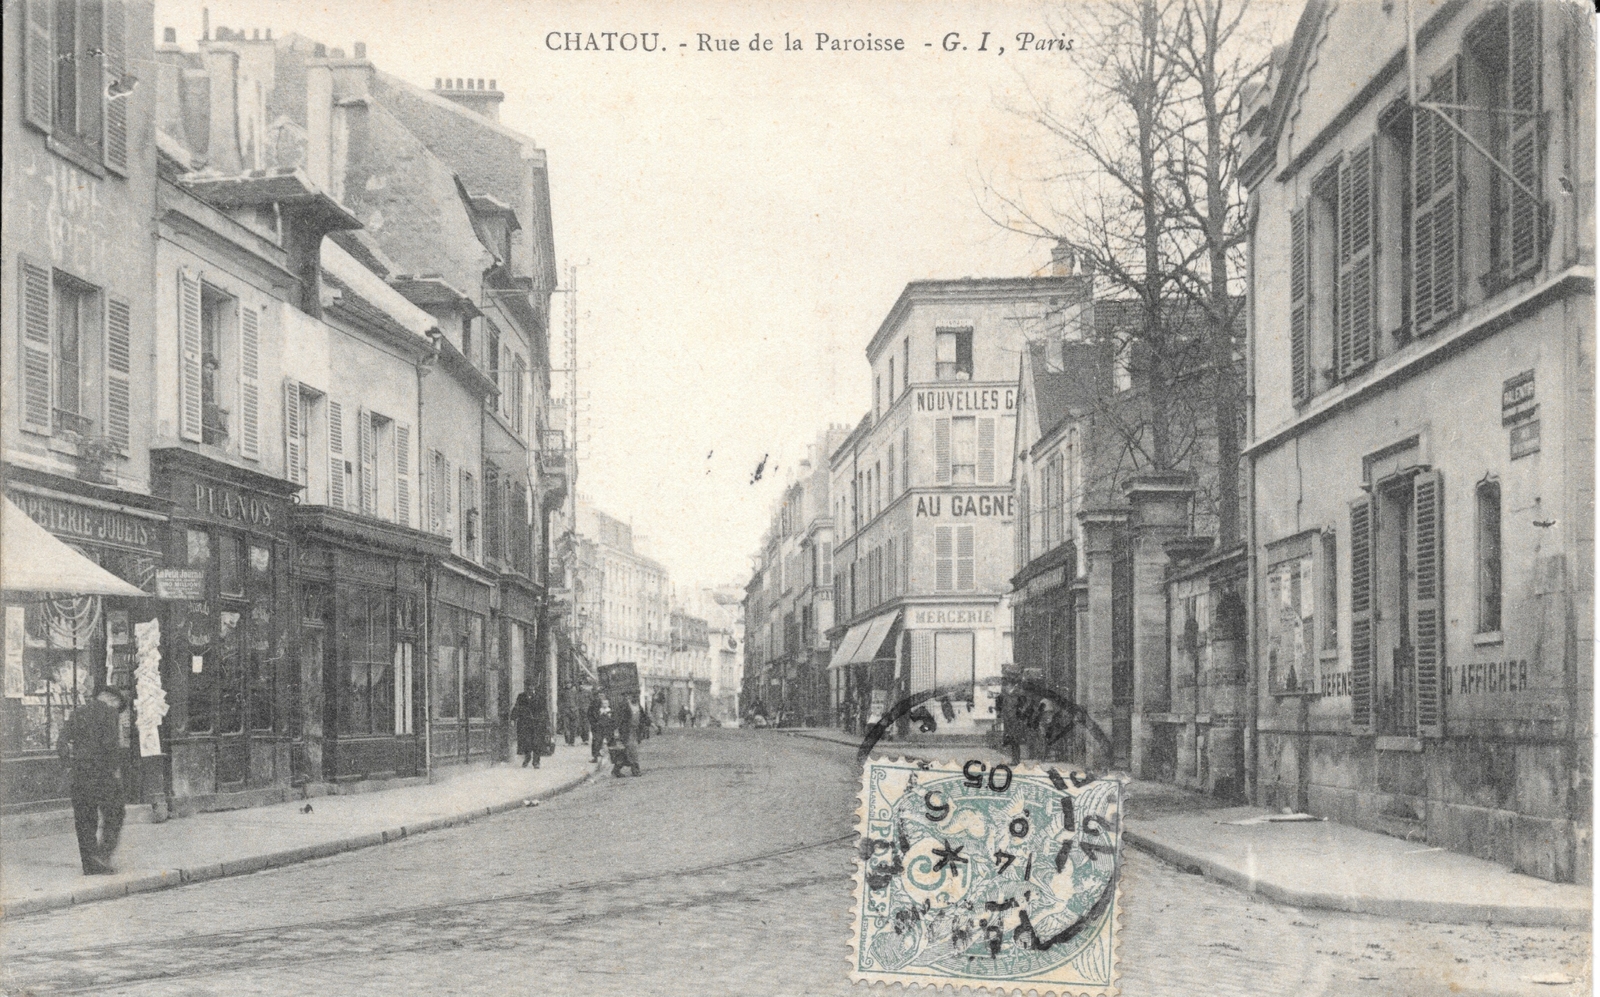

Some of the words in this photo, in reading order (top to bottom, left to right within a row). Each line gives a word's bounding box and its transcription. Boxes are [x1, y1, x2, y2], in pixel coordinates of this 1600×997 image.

[917, 389, 999, 411] NOUVELLES
[1005, 389, 1018, 410] G
[195, 483, 271, 527] PIANOS
[916, 495, 941, 518] AU
[951, 494, 1014, 517] GAGNE
[99, 512, 148, 546] JOUETS
[914, 608, 994, 624] MERCERIE
